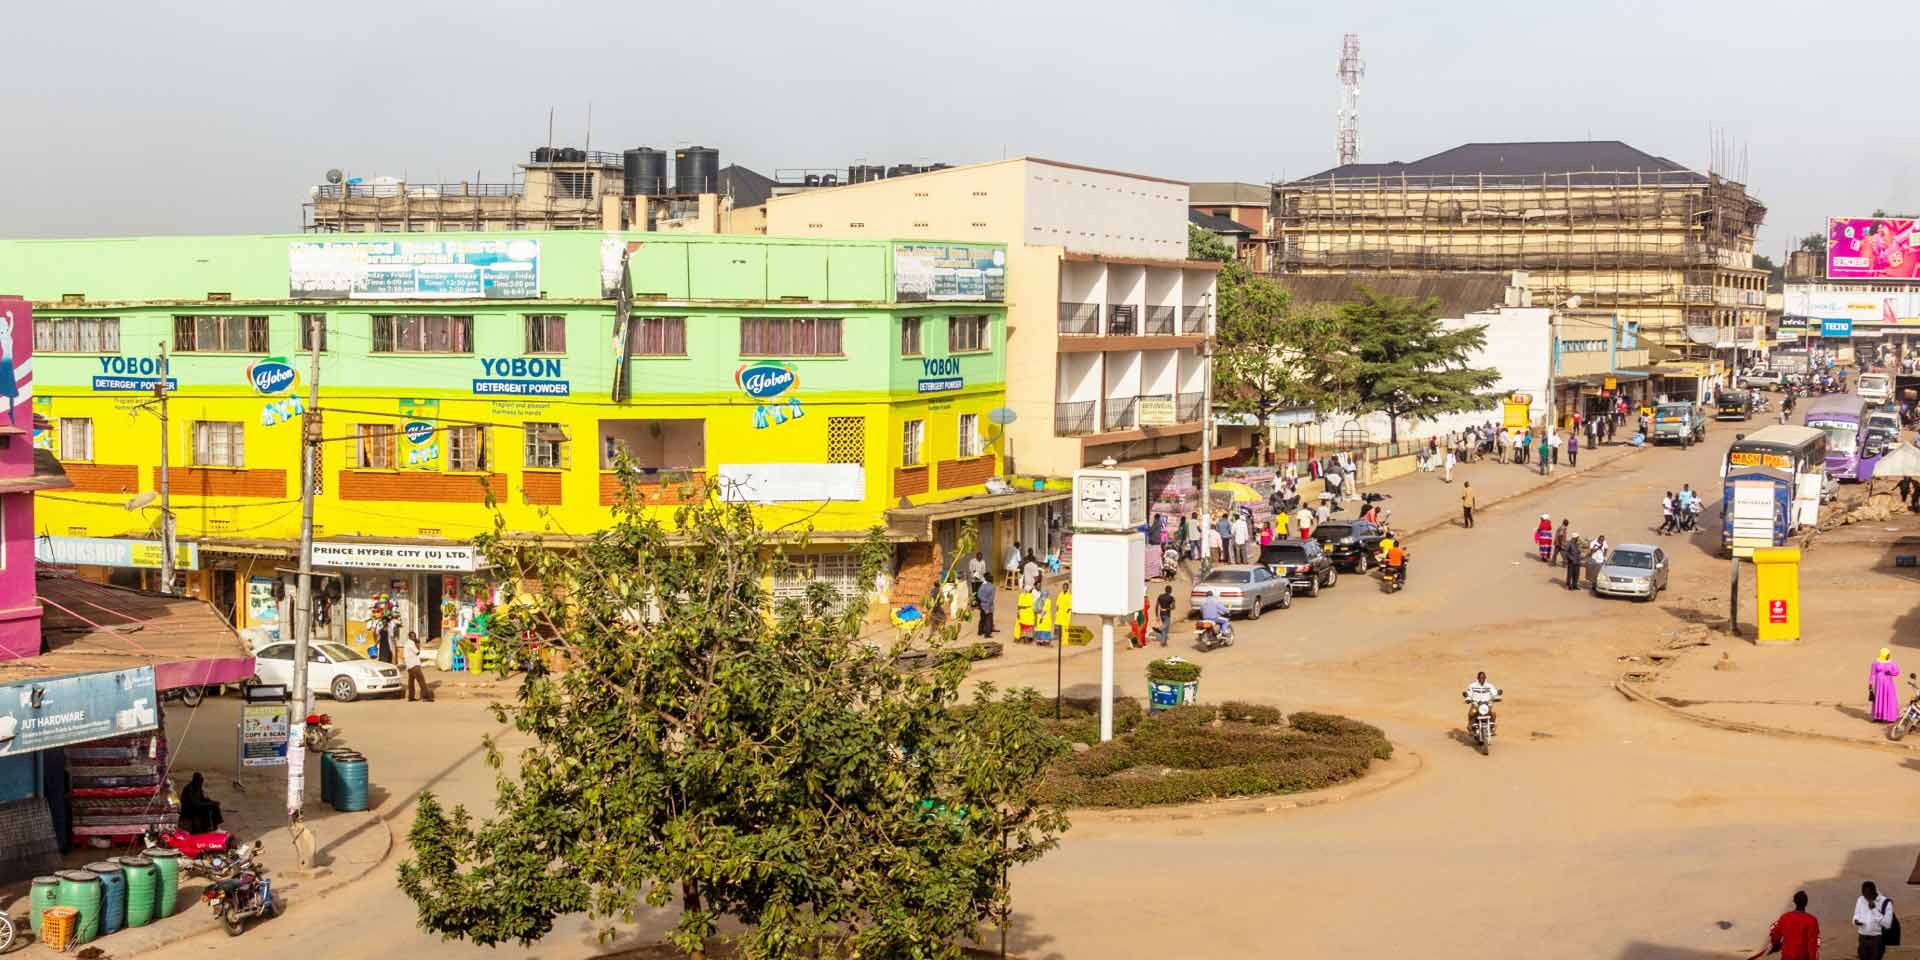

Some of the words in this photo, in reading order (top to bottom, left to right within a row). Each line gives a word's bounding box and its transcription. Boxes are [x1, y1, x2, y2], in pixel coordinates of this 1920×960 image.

[100, 356, 170, 375] YOBON
[480, 357, 561, 378] YOBON
[922, 357, 960, 377] YOBON
[140, 380, 176, 391] POWER
[475, 382, 528, 393] DETERGENT
[528, 383, 569, 394] POWDER
[1732, 452, 1760, 466] MASH
[313, 546, 354, 555] PRINCE
[357, 548, 393, 557] HYPER
[397, 549, 421, 558] CITY
[424, 550, 442, 560] (U)
[446, 551, 470, 560] LTD.
[38, 710, 86, 727] HARDWARE
